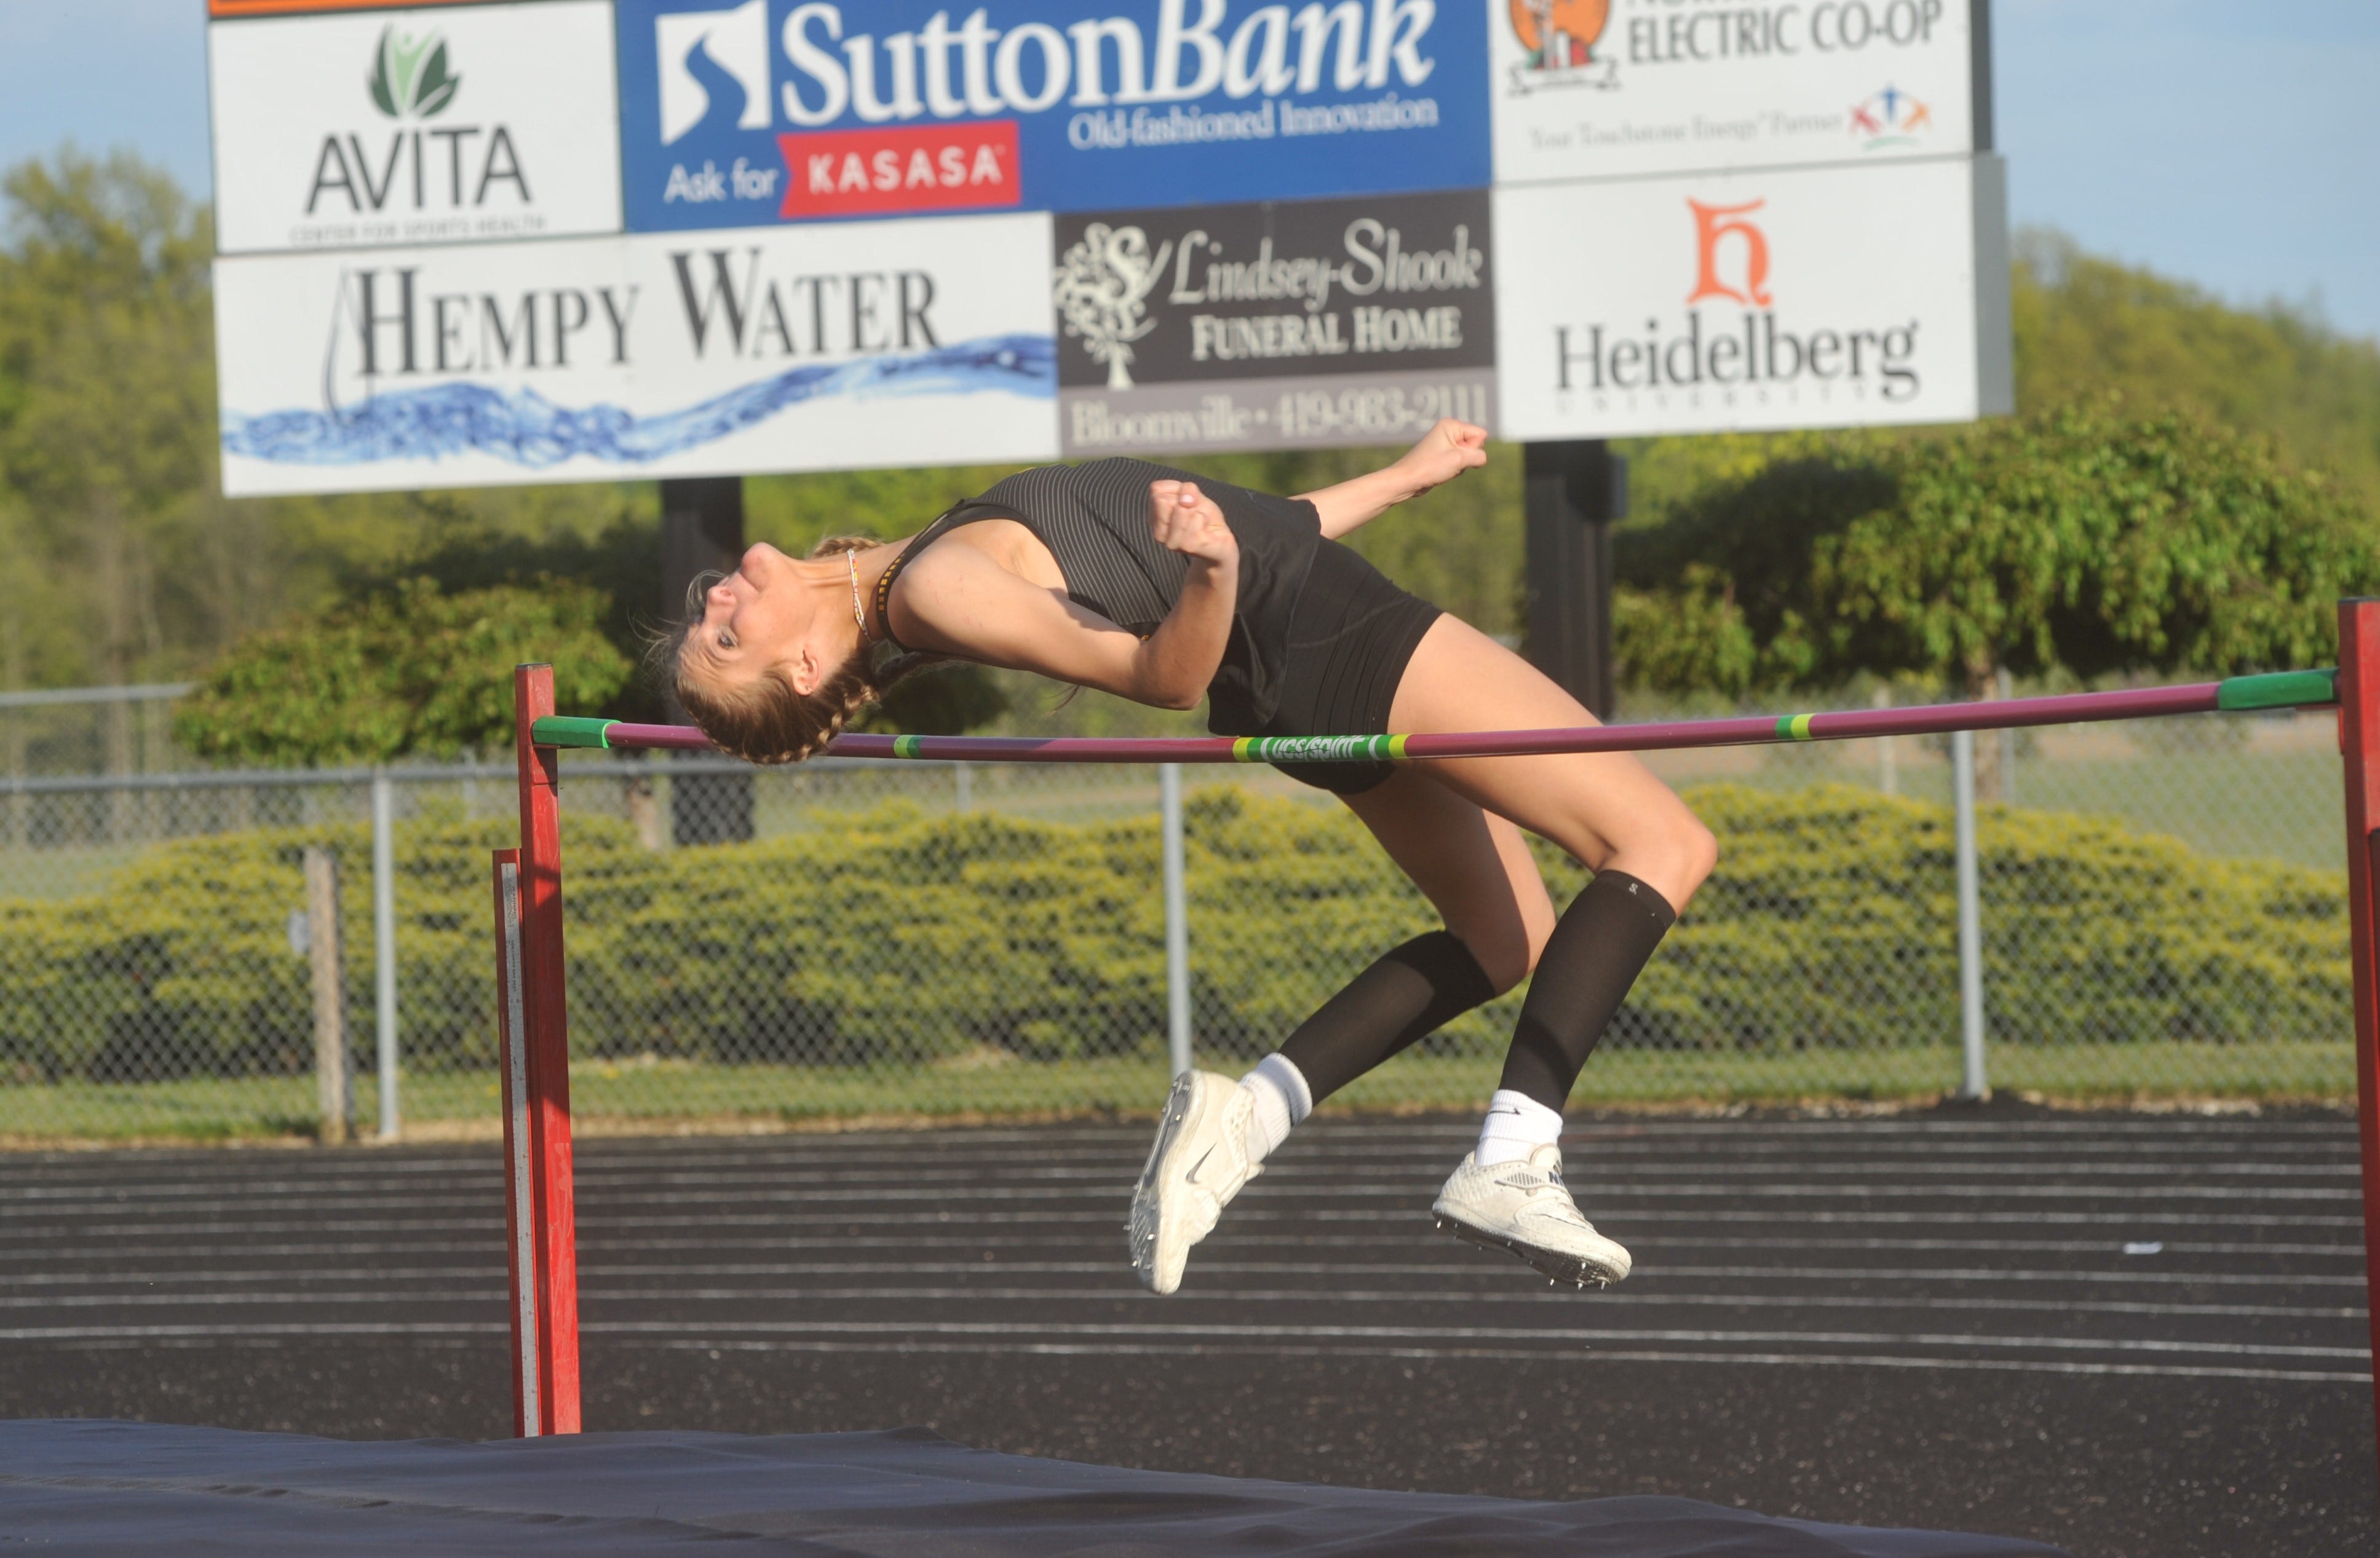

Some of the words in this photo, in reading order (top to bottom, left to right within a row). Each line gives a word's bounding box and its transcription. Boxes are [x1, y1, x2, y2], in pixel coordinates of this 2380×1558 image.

[1628, 5, 1801, 64] ELECTRIC
[1811, 0, 1943, 53] CO-OP
[1068, 98, 1275, 151] Old-fashioned
[1280, 91, 1439, 136] Innovation
[304, 124, 533, 216] AVITA
[664, 159, 727, 204] Ask
[730, 156, 778, 200] for
[808, 143, 1004, 196] KASASA
[1170, 218, 1483, 312] Lindsey-Shook
[1191, 310, 1349, 360] FUNERAL
[1353, 306, 1462, 353] HOME
[1554, 310, 1920, 403] Heidelberg
[1071, 394, 1251, 447] Bloomville
